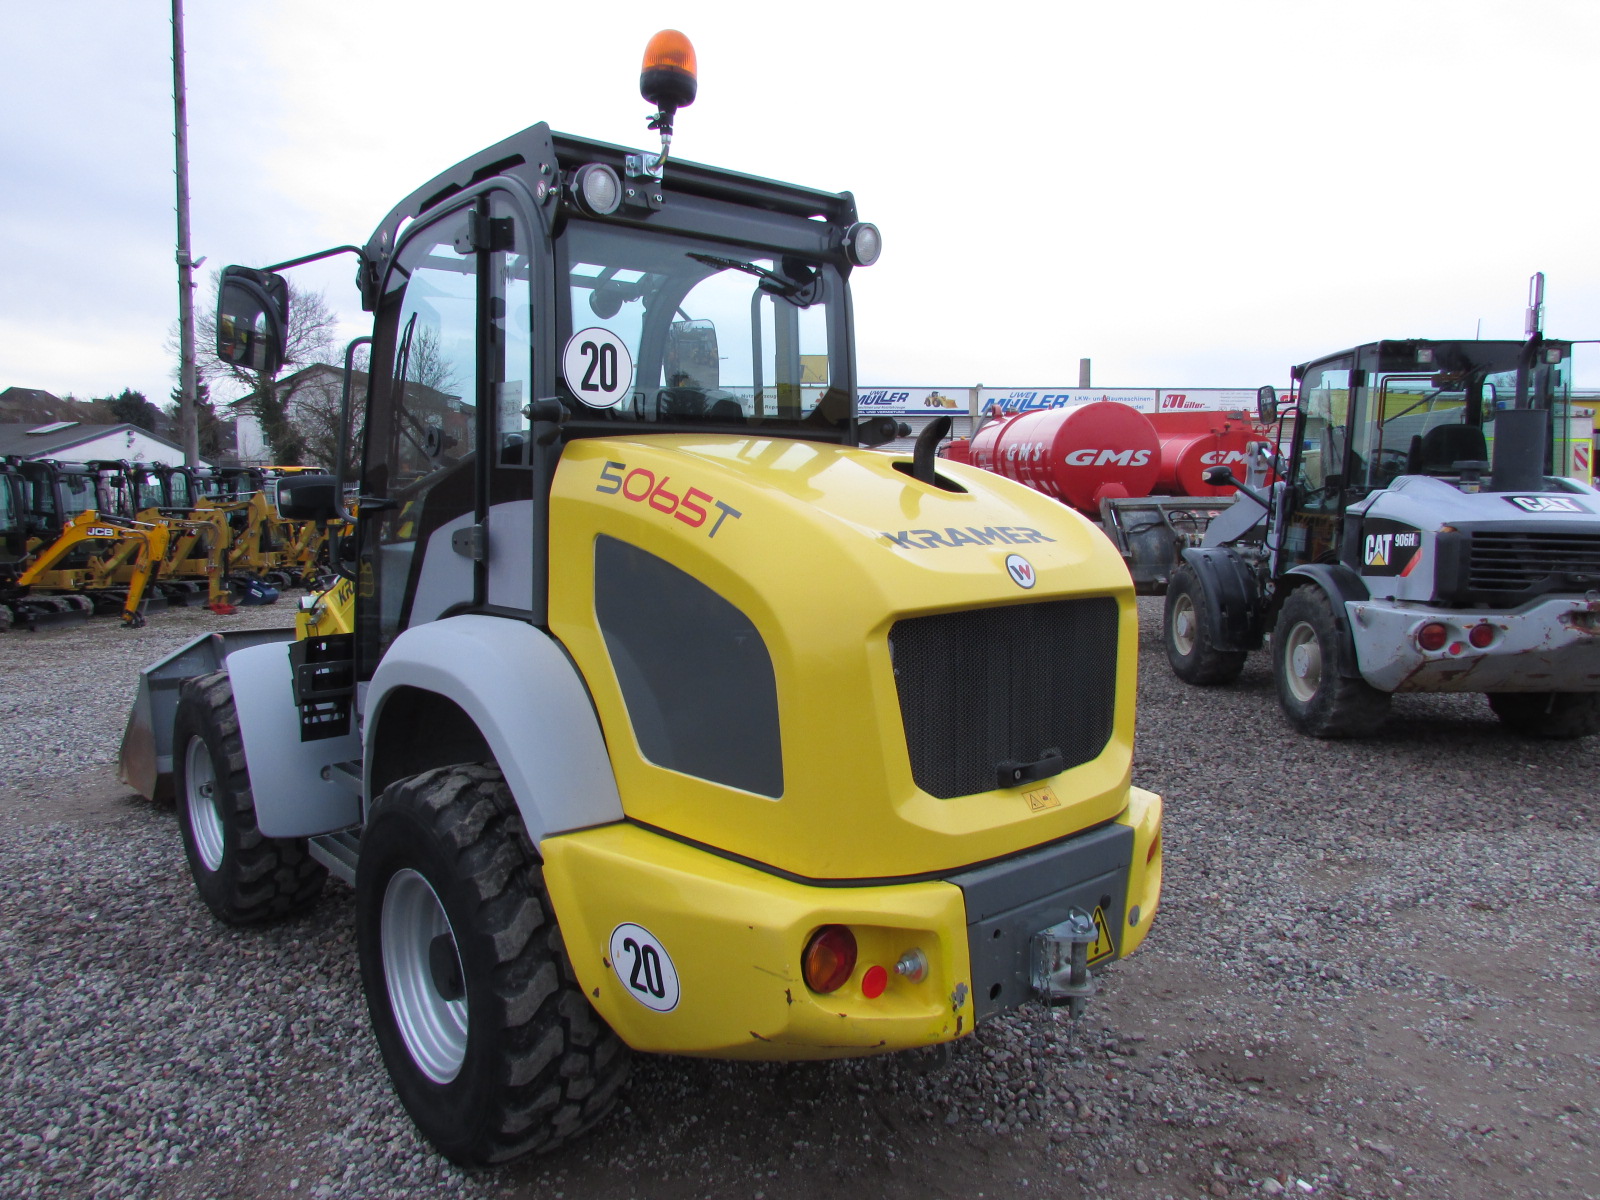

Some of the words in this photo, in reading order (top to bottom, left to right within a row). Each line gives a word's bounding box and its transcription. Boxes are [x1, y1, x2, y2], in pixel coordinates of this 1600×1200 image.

[581, 341, 618, 392] 20
[1006, 441, 1043, 462] GMS
[1065, 449, 1152, 466] GMS
[1200, 450, 1248, 464] GM
[596, 461, 742, 538] 5065T
[1512, 497, 1583, 512] CAT
[87, 527, 114, 536] JCB
[880, 526, 1057, 549] KRAMER
[1364, 533, 1393, 566] CAT
[623, 937, 666, 998] 20
